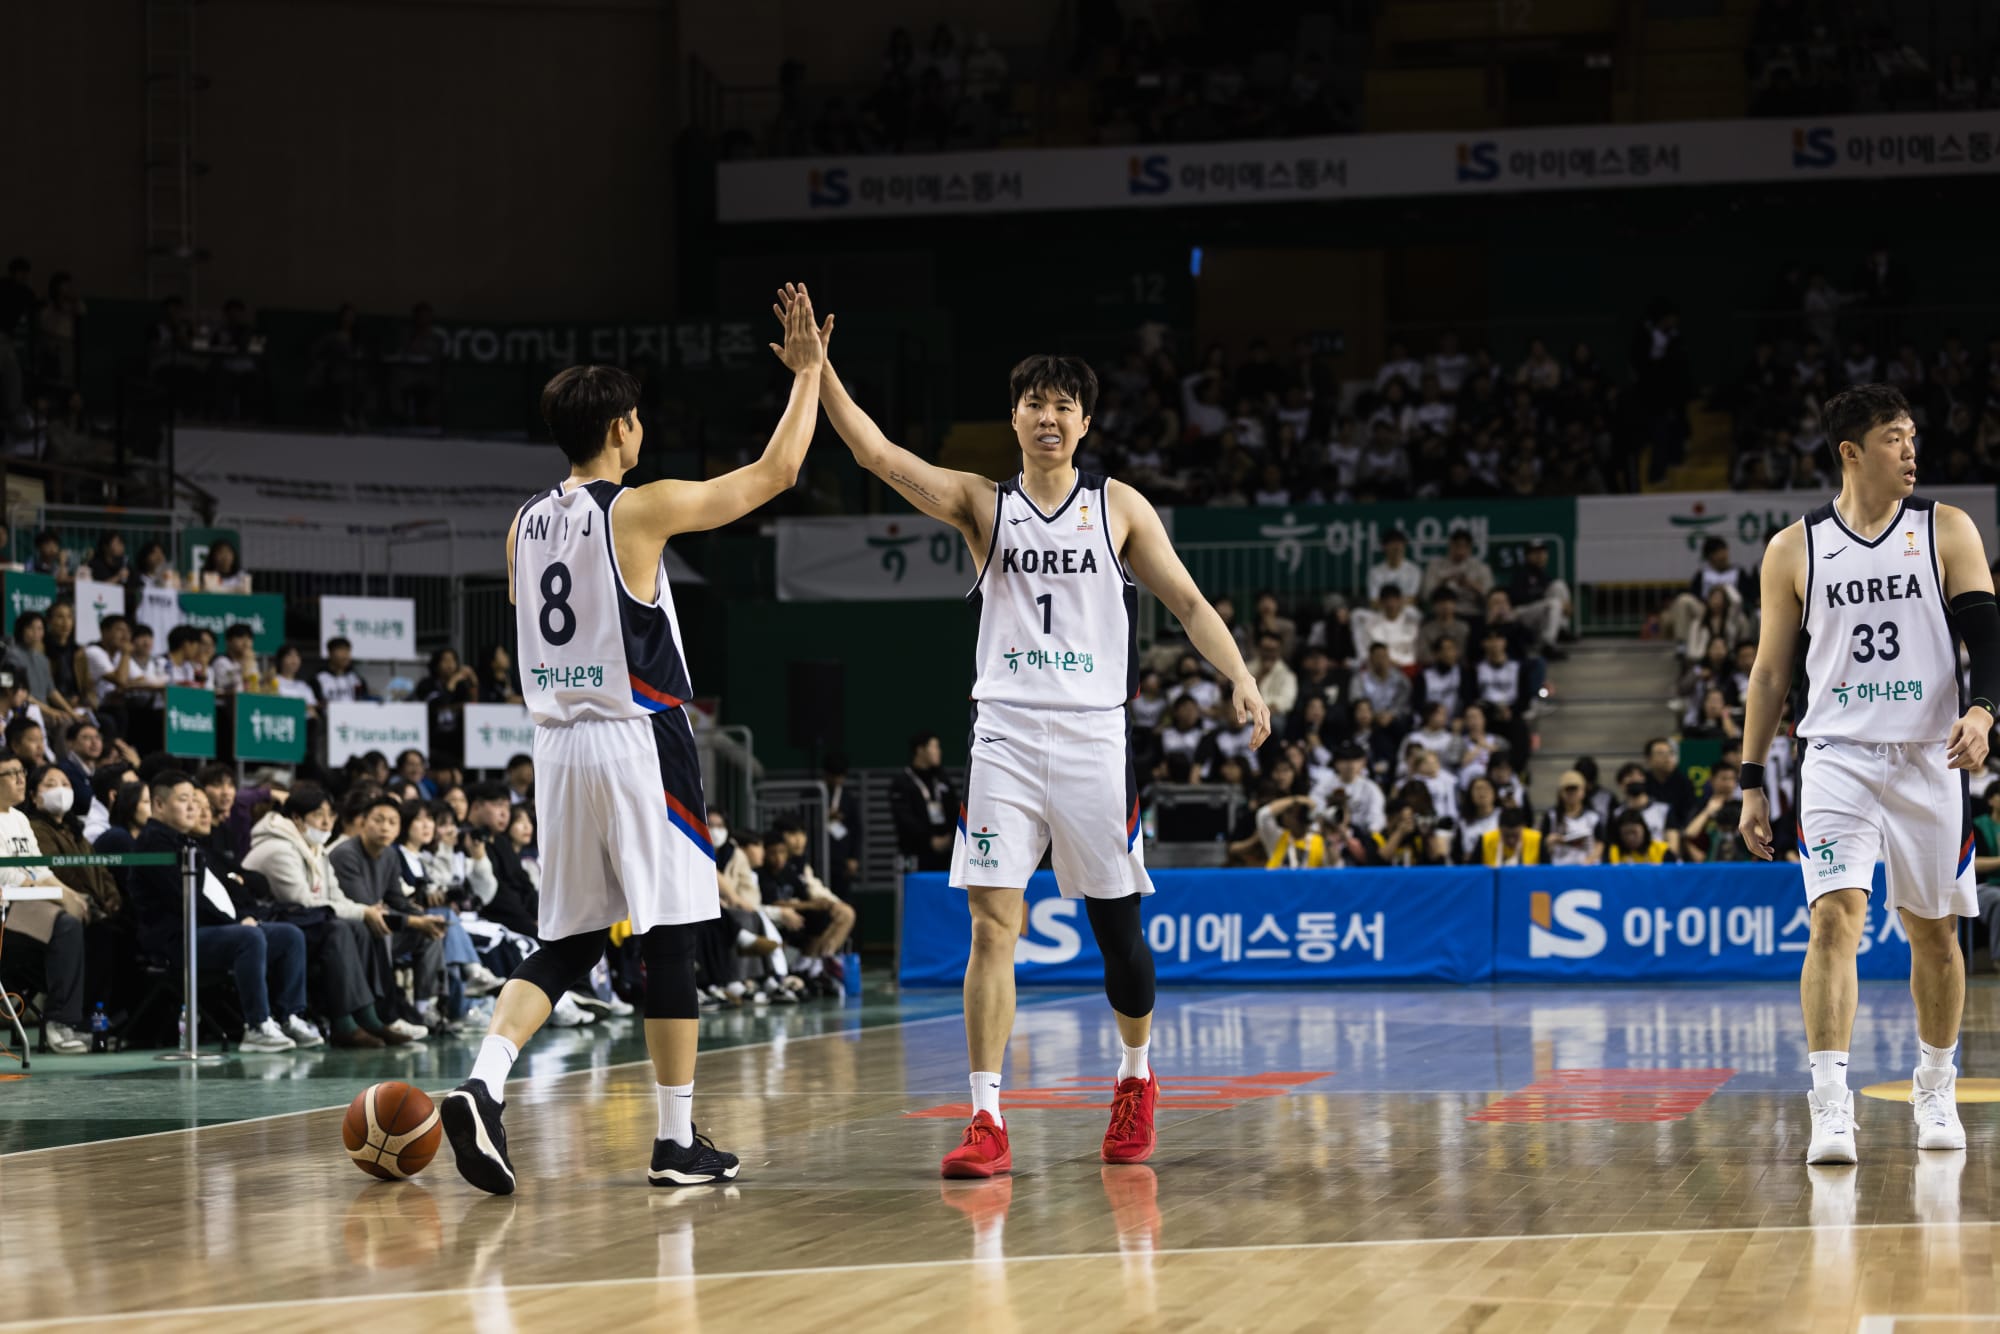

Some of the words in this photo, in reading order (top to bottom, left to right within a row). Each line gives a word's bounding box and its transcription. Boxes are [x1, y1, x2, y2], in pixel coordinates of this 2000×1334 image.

[1509, 144, 1681, 178] 아이에스동서
[1848, 131, 2000, 166] 아이에스동
[859, 171, 1022, 204] 아이에스동서
[1181, 158, 1347, 192] 아이에스동서
[1131, 272, 1167, 304] 12
[591, 321, 757, 368] 디지털존
[524, 514, 550, 541] AN
[582, 510, 592, 537] J
[1002, 548, 1098, 574] KOREA
[539, 561, 577, 646] 8
[1825, 573, 1923, 609] KOREA
[1036, 593, 1052, 634] 1
[1852, 620, 1901, 663] 33
[1026, 649, 1094, 673] 하나은행
[1857, 679, 1923, 703] 하나은행
[1142, 911, 1386, 963] 이에스동서
[1621, 904, 1908, 957] 아이에스
